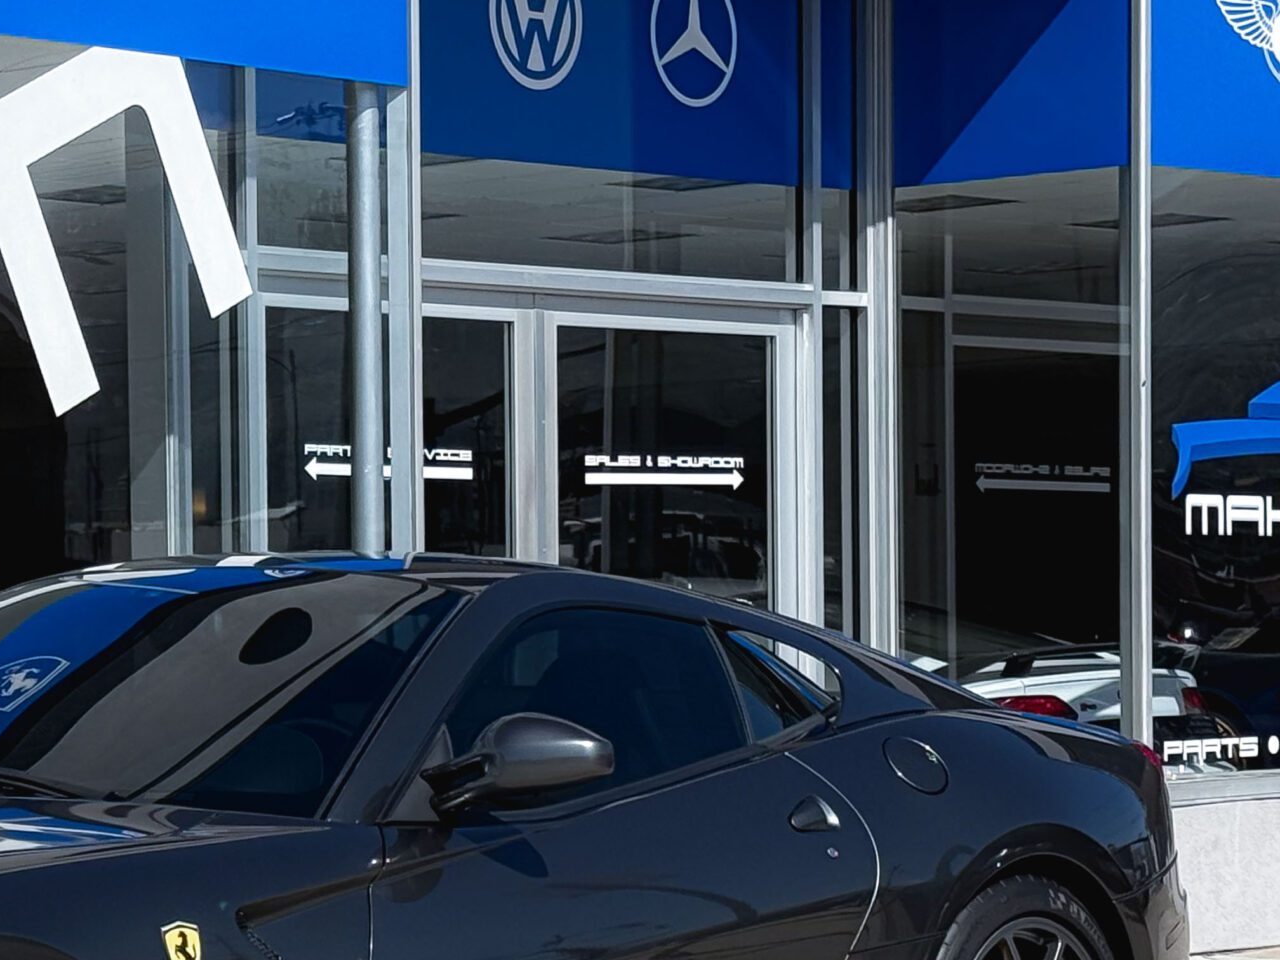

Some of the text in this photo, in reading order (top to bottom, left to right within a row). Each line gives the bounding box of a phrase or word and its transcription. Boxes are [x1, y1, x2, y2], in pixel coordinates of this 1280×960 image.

[584, 454, 745, 469] SALES & SHOWROOM
[1162, 736, 1260, 763] PARTS
